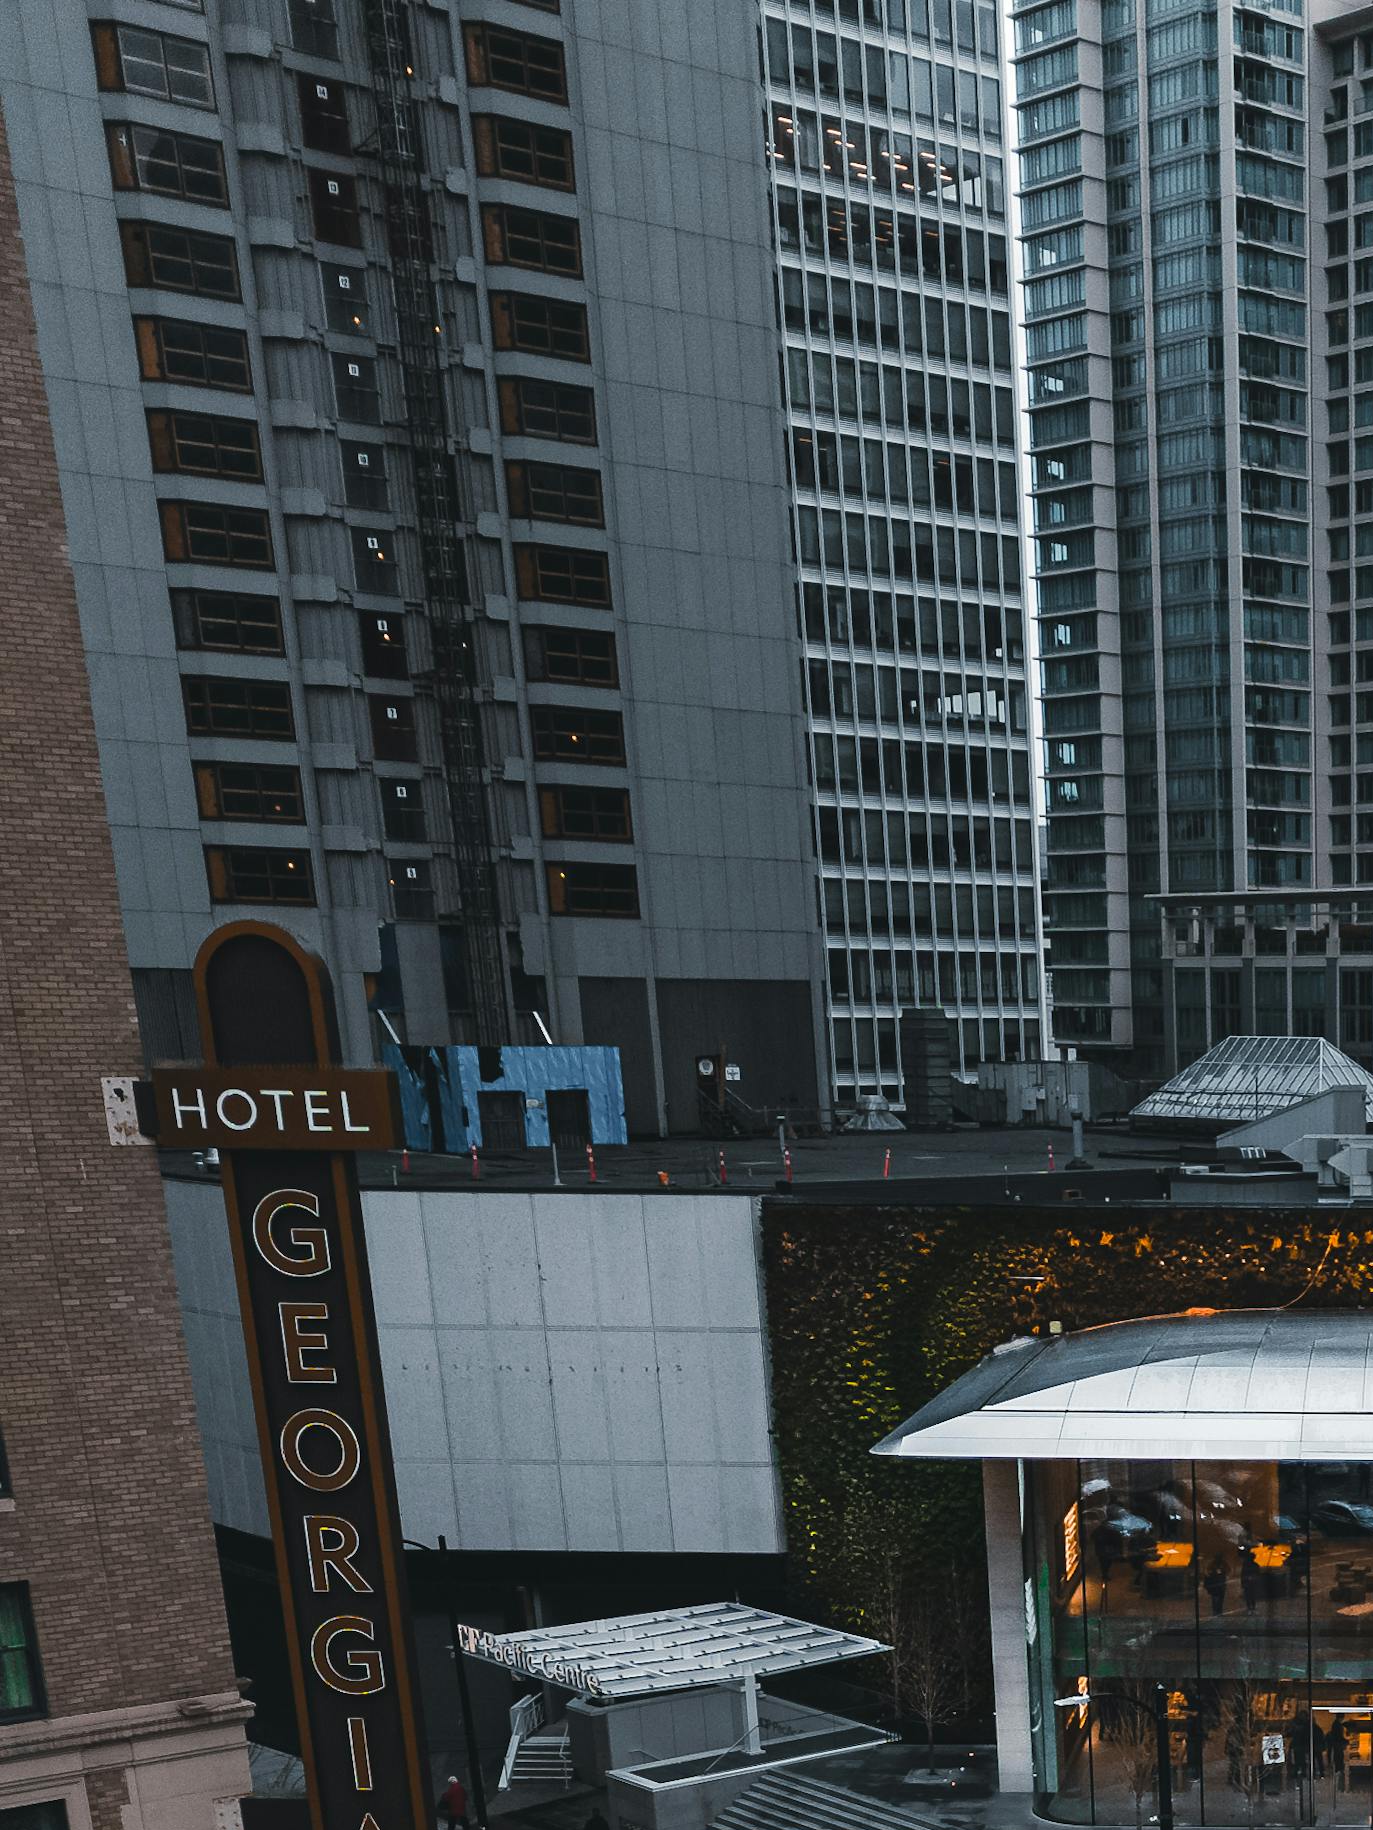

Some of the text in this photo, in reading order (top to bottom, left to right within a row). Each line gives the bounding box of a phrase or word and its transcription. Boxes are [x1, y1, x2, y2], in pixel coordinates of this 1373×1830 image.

[171, 1087, 370, 1132] HOTEL
[483, 1631, 538, 1674] Pacific
[540, 1652, 600, 1696] Centre
